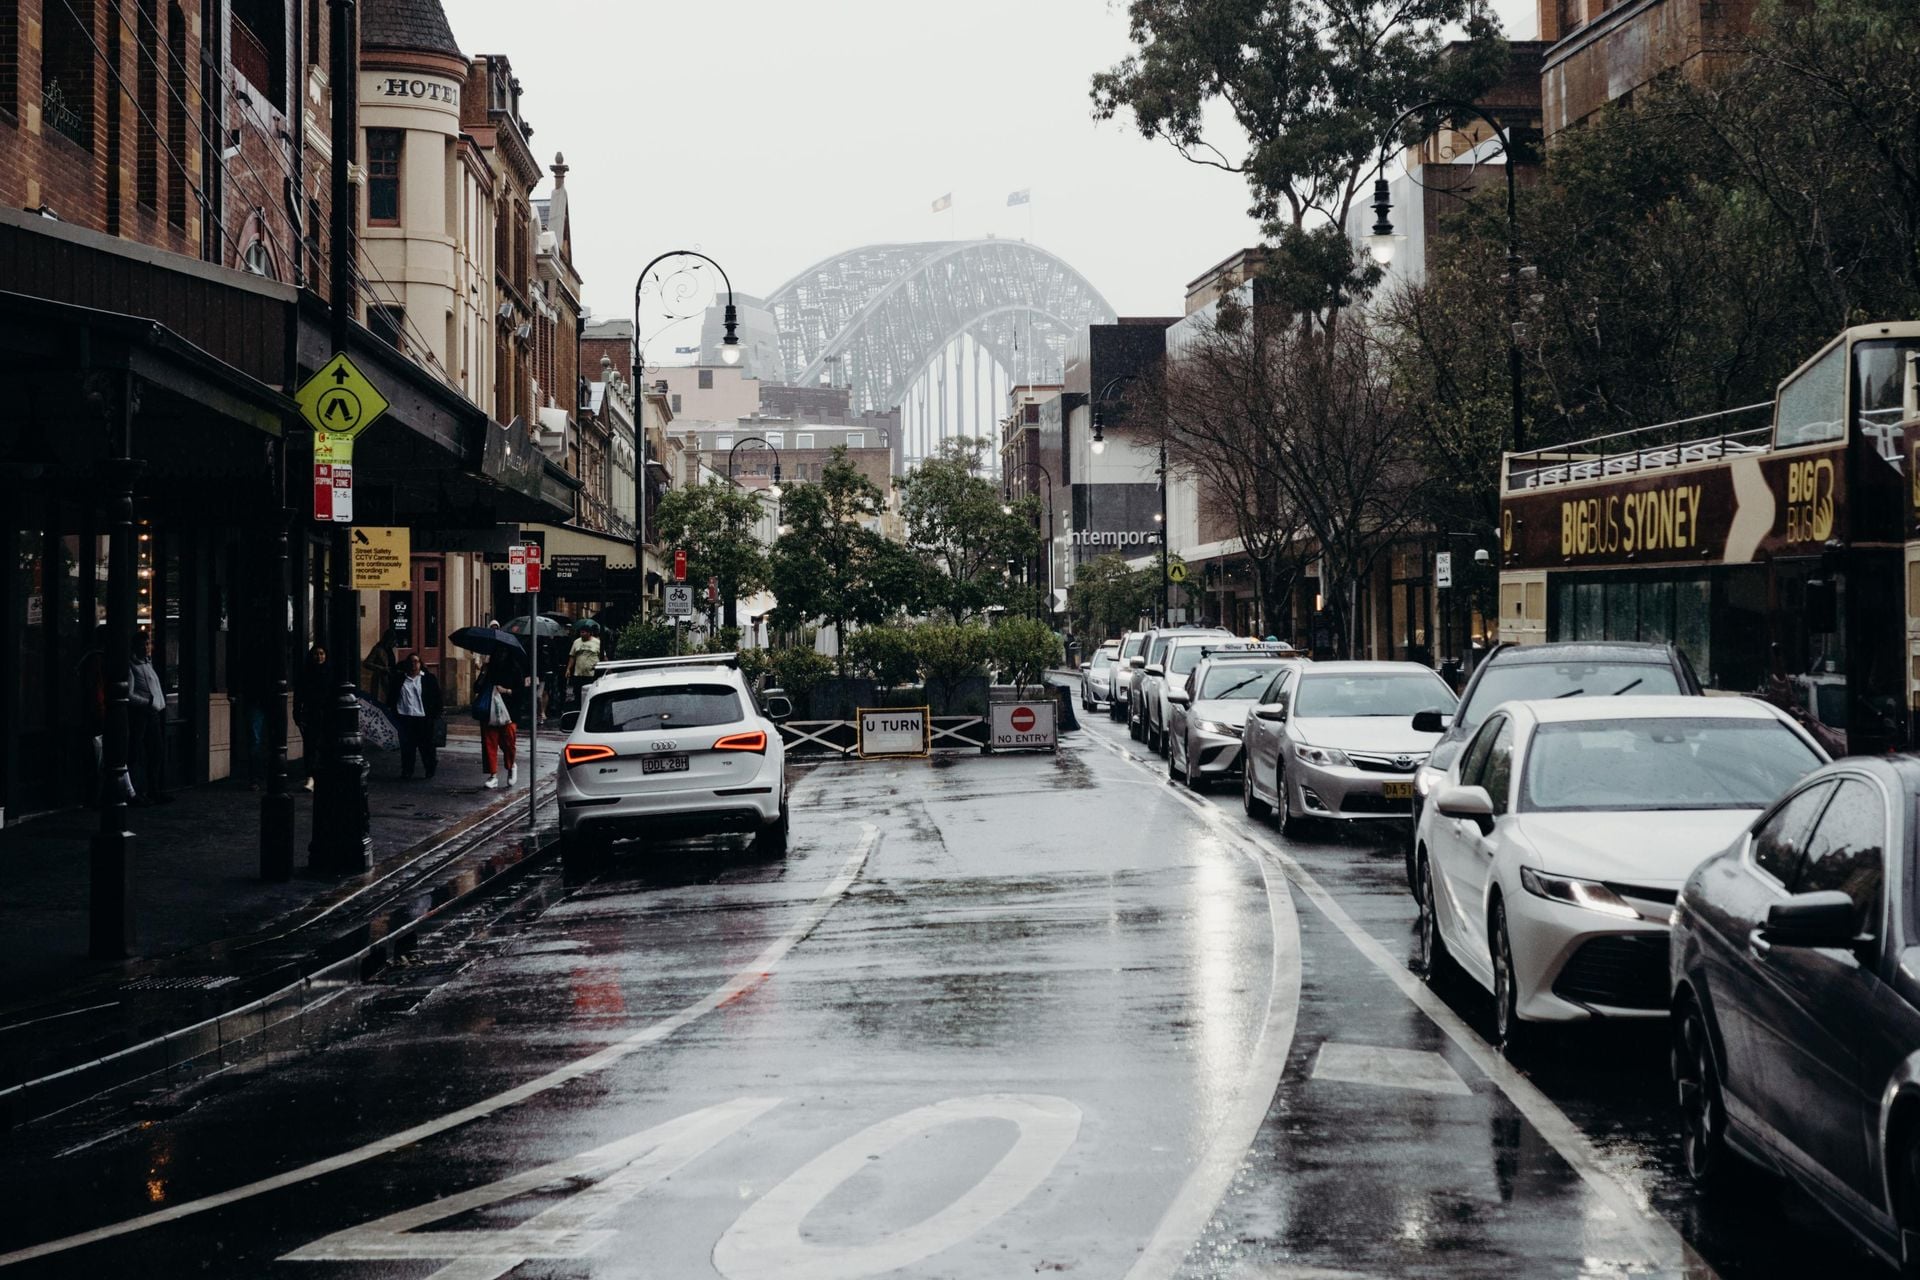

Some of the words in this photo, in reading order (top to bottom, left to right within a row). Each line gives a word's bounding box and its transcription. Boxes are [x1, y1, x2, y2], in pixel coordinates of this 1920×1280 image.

[335, 479, 349, 487] ZONE
[1788, 460, 1814, 503] BIG
[1623, 485, 1701, 551] SYDNEY
[1787, 505, 1813, 543] BUS
[866, 721, 875, 732] U
[881, 720, 920, 731] TURN
[998, 735, 1011, 743] NO
[1015, 734, 1048, 743] ENTRY
